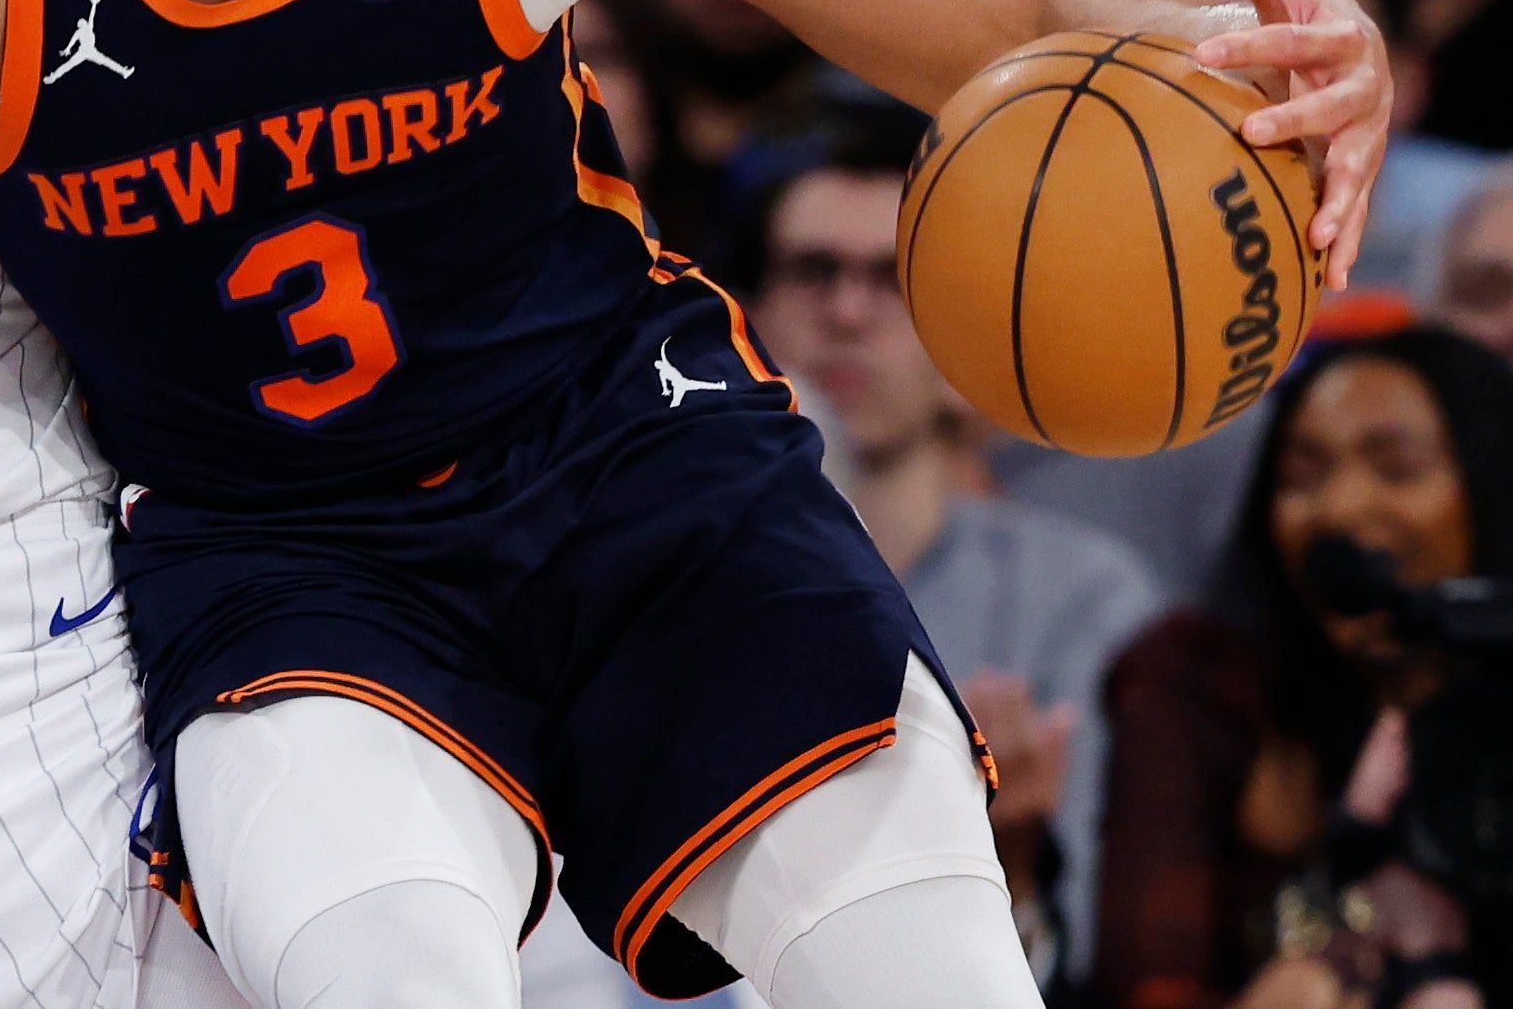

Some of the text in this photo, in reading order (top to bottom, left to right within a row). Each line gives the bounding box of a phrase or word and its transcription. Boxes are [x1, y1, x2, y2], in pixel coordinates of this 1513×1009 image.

[27, 64, 506, 238] NEW YORK
[218, 213, 407, 428] 3
[1204, 167, 1280, 430] Wilson
